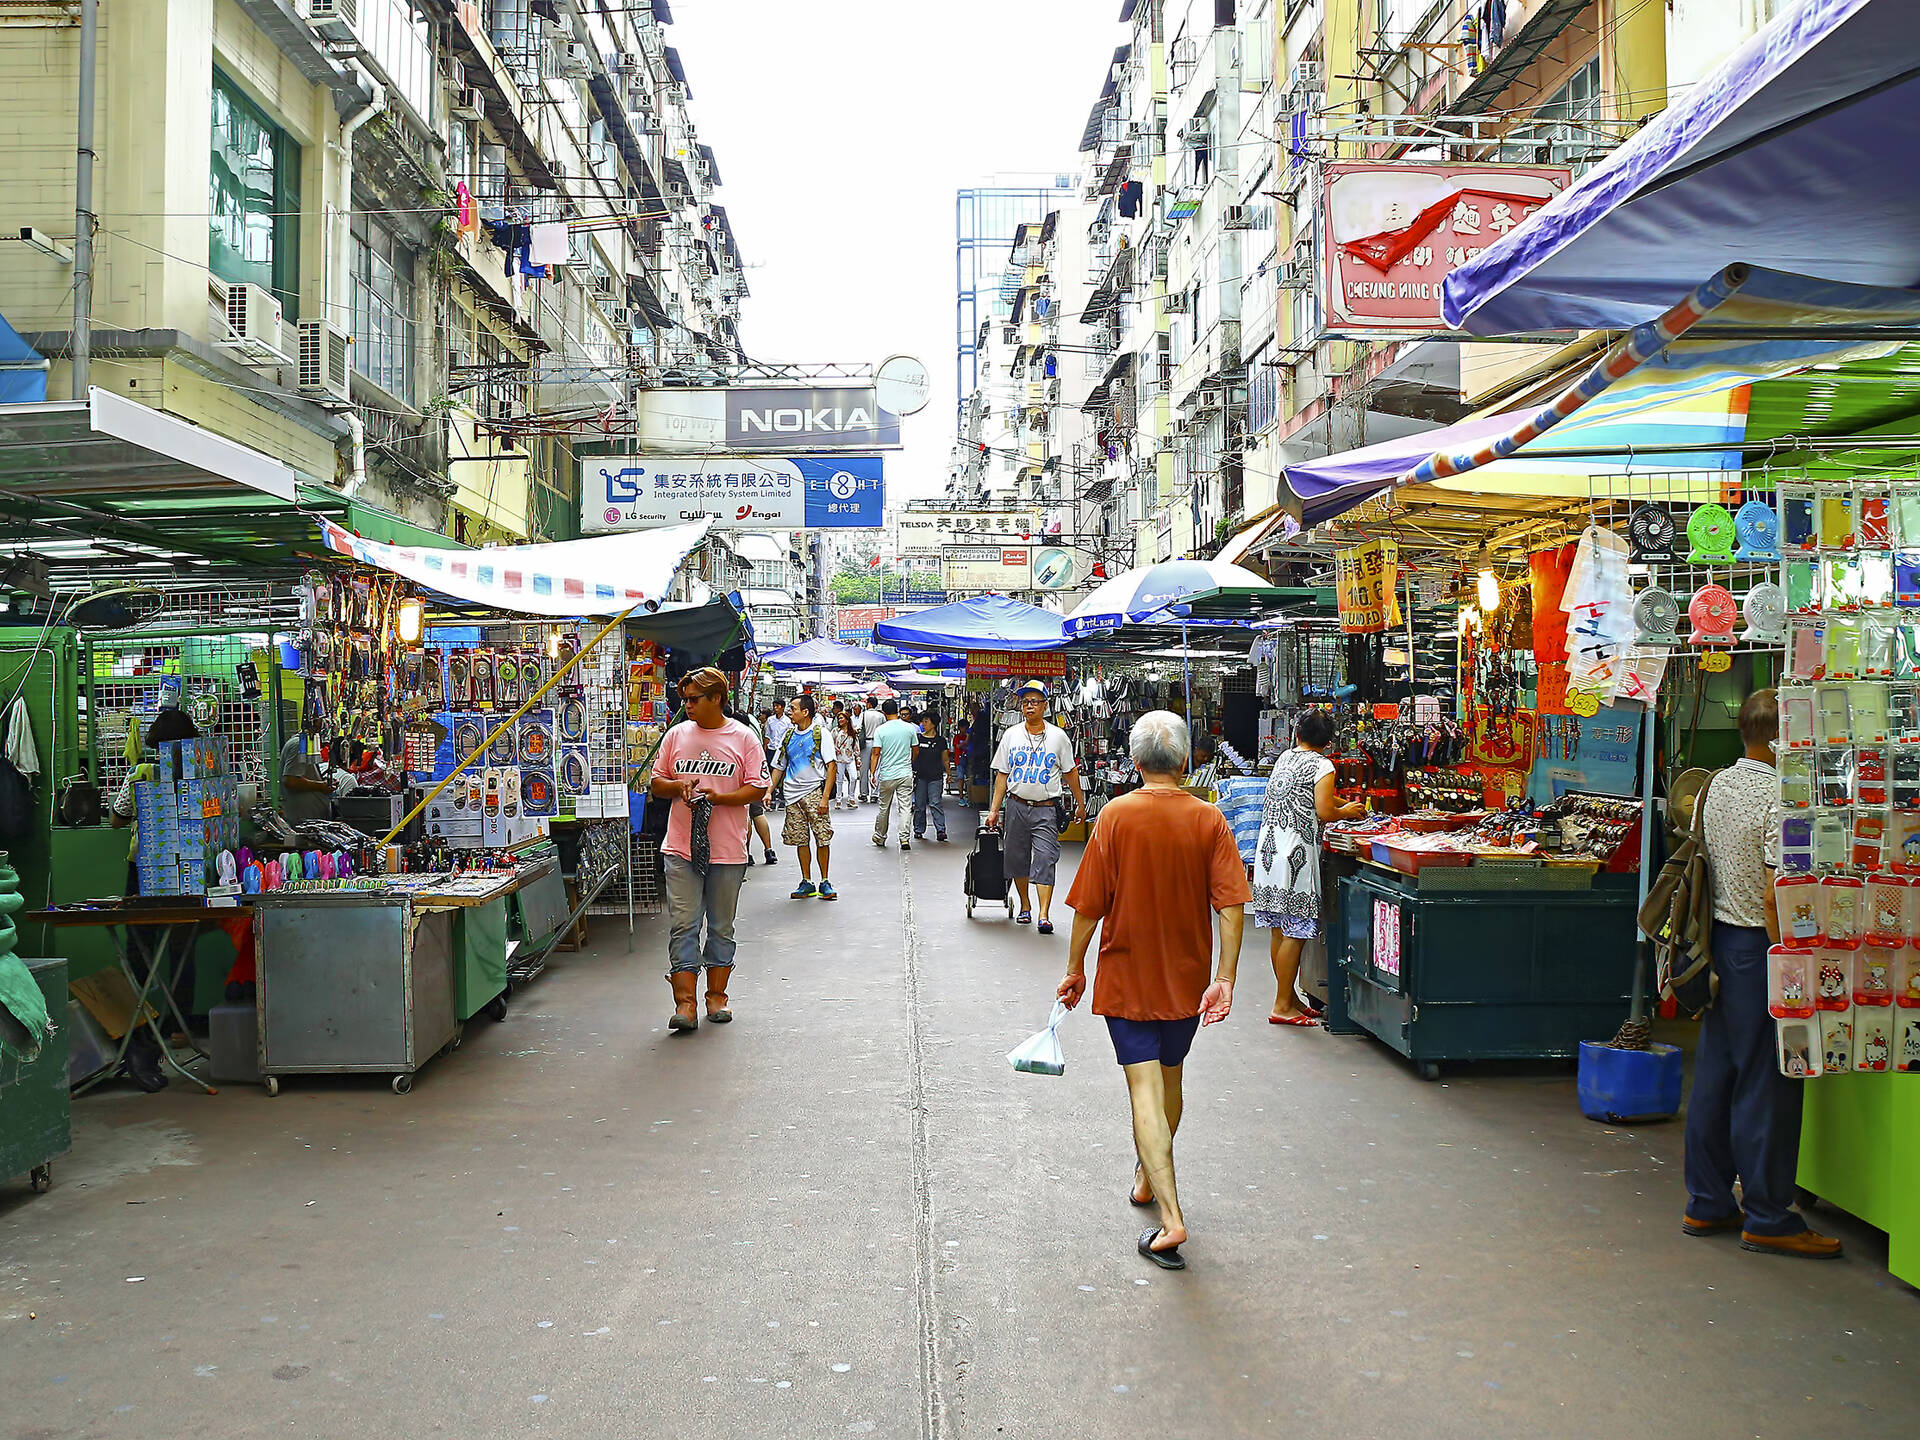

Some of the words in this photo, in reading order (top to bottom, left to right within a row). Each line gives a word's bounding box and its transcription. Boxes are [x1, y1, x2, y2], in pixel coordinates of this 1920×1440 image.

[665, 415, 687, 432] Top
[740, 408, 875, 432] NOKIA
[653, 473, 792, 489] 集安系統有限公司
[653, 491, 698, 499] Integrated
[700, 490, 726, 499] Safety
[728, 490, 759, 499] System
[760, 489, 792, 497] Limited
[827, 503, 861, 513] 總代理
[625, 512, 638, 520] LG
[639, 513, 667, 521] Security
[679, 510, 723, 521] CyViw
[752, 511, 781, 521] Engal
[674, 760, 736, 777] SAKURA
[1008, 768, 1051, 785] ONG
